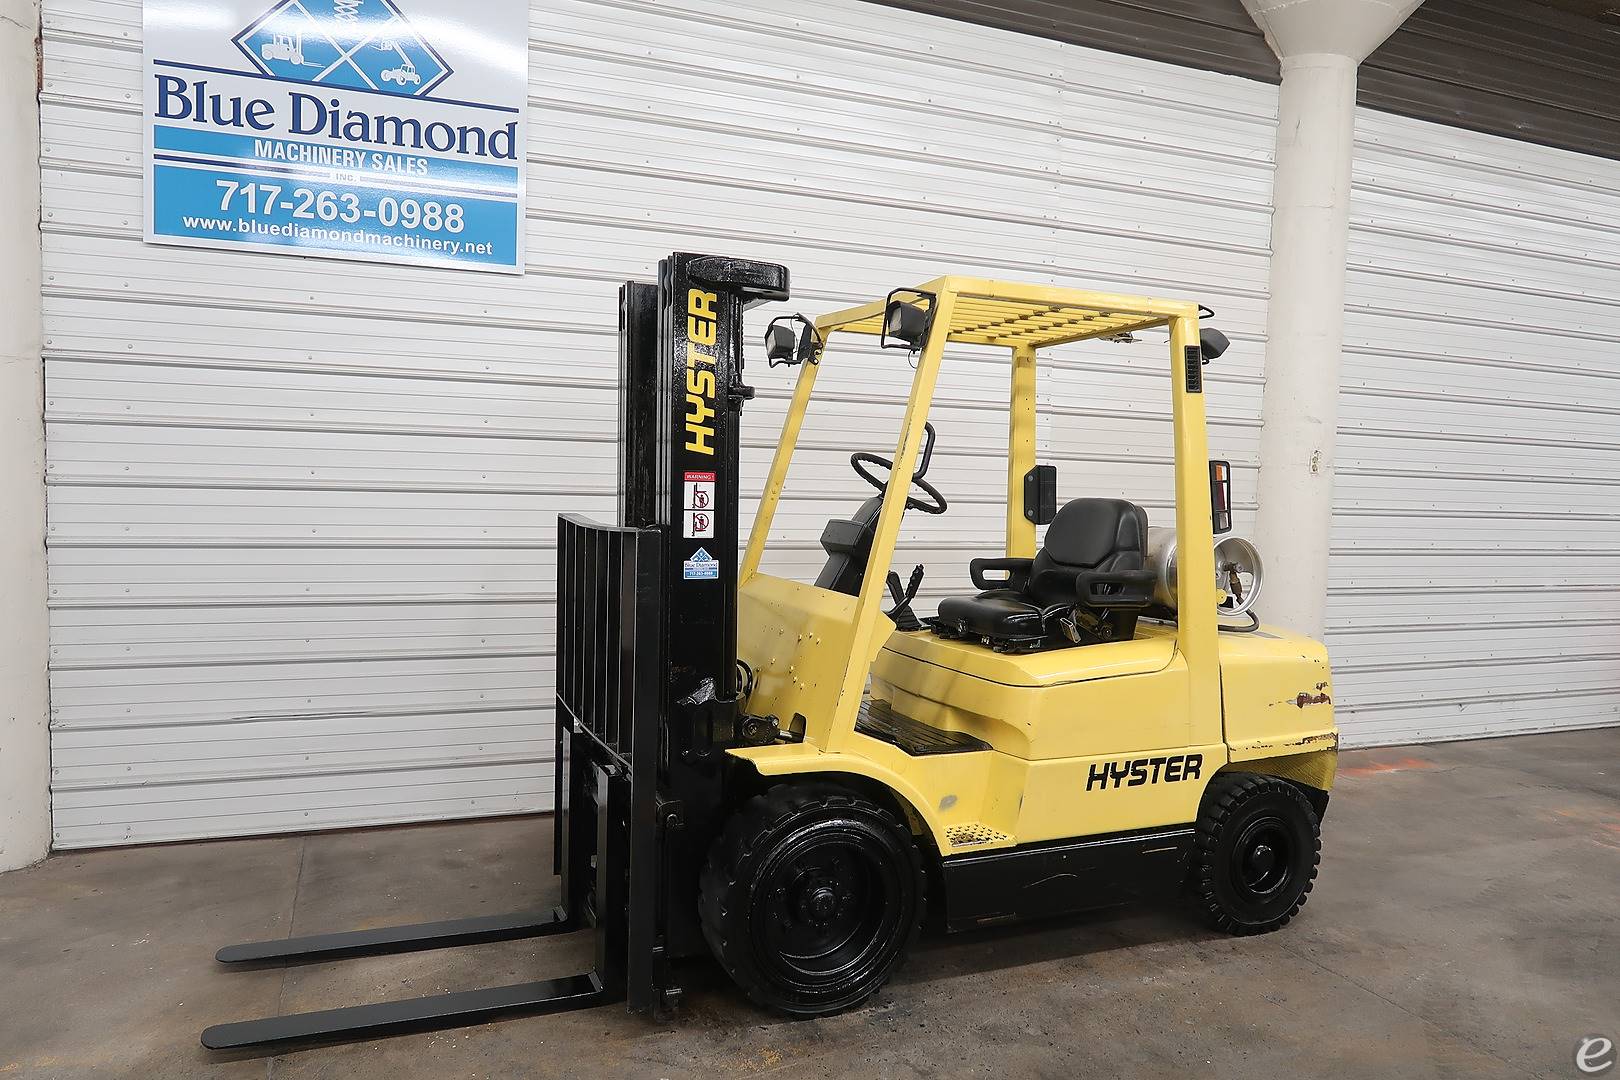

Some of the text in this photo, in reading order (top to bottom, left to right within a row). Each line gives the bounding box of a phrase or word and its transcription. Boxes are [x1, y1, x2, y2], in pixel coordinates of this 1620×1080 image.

[154, 74, 518, 160] Blue Diamond
[254, 139, 428, 176] MACHINERY SALES
[335, 173, 358, 183] INC.
[215, 179, 465, 233] 717-263-0988
[182, 215, 493, 255] www.bluediamondmachinery.net
[685, 288, 717, 455] HYSTER
[1086, 753, 1203, 791] HYSTER
